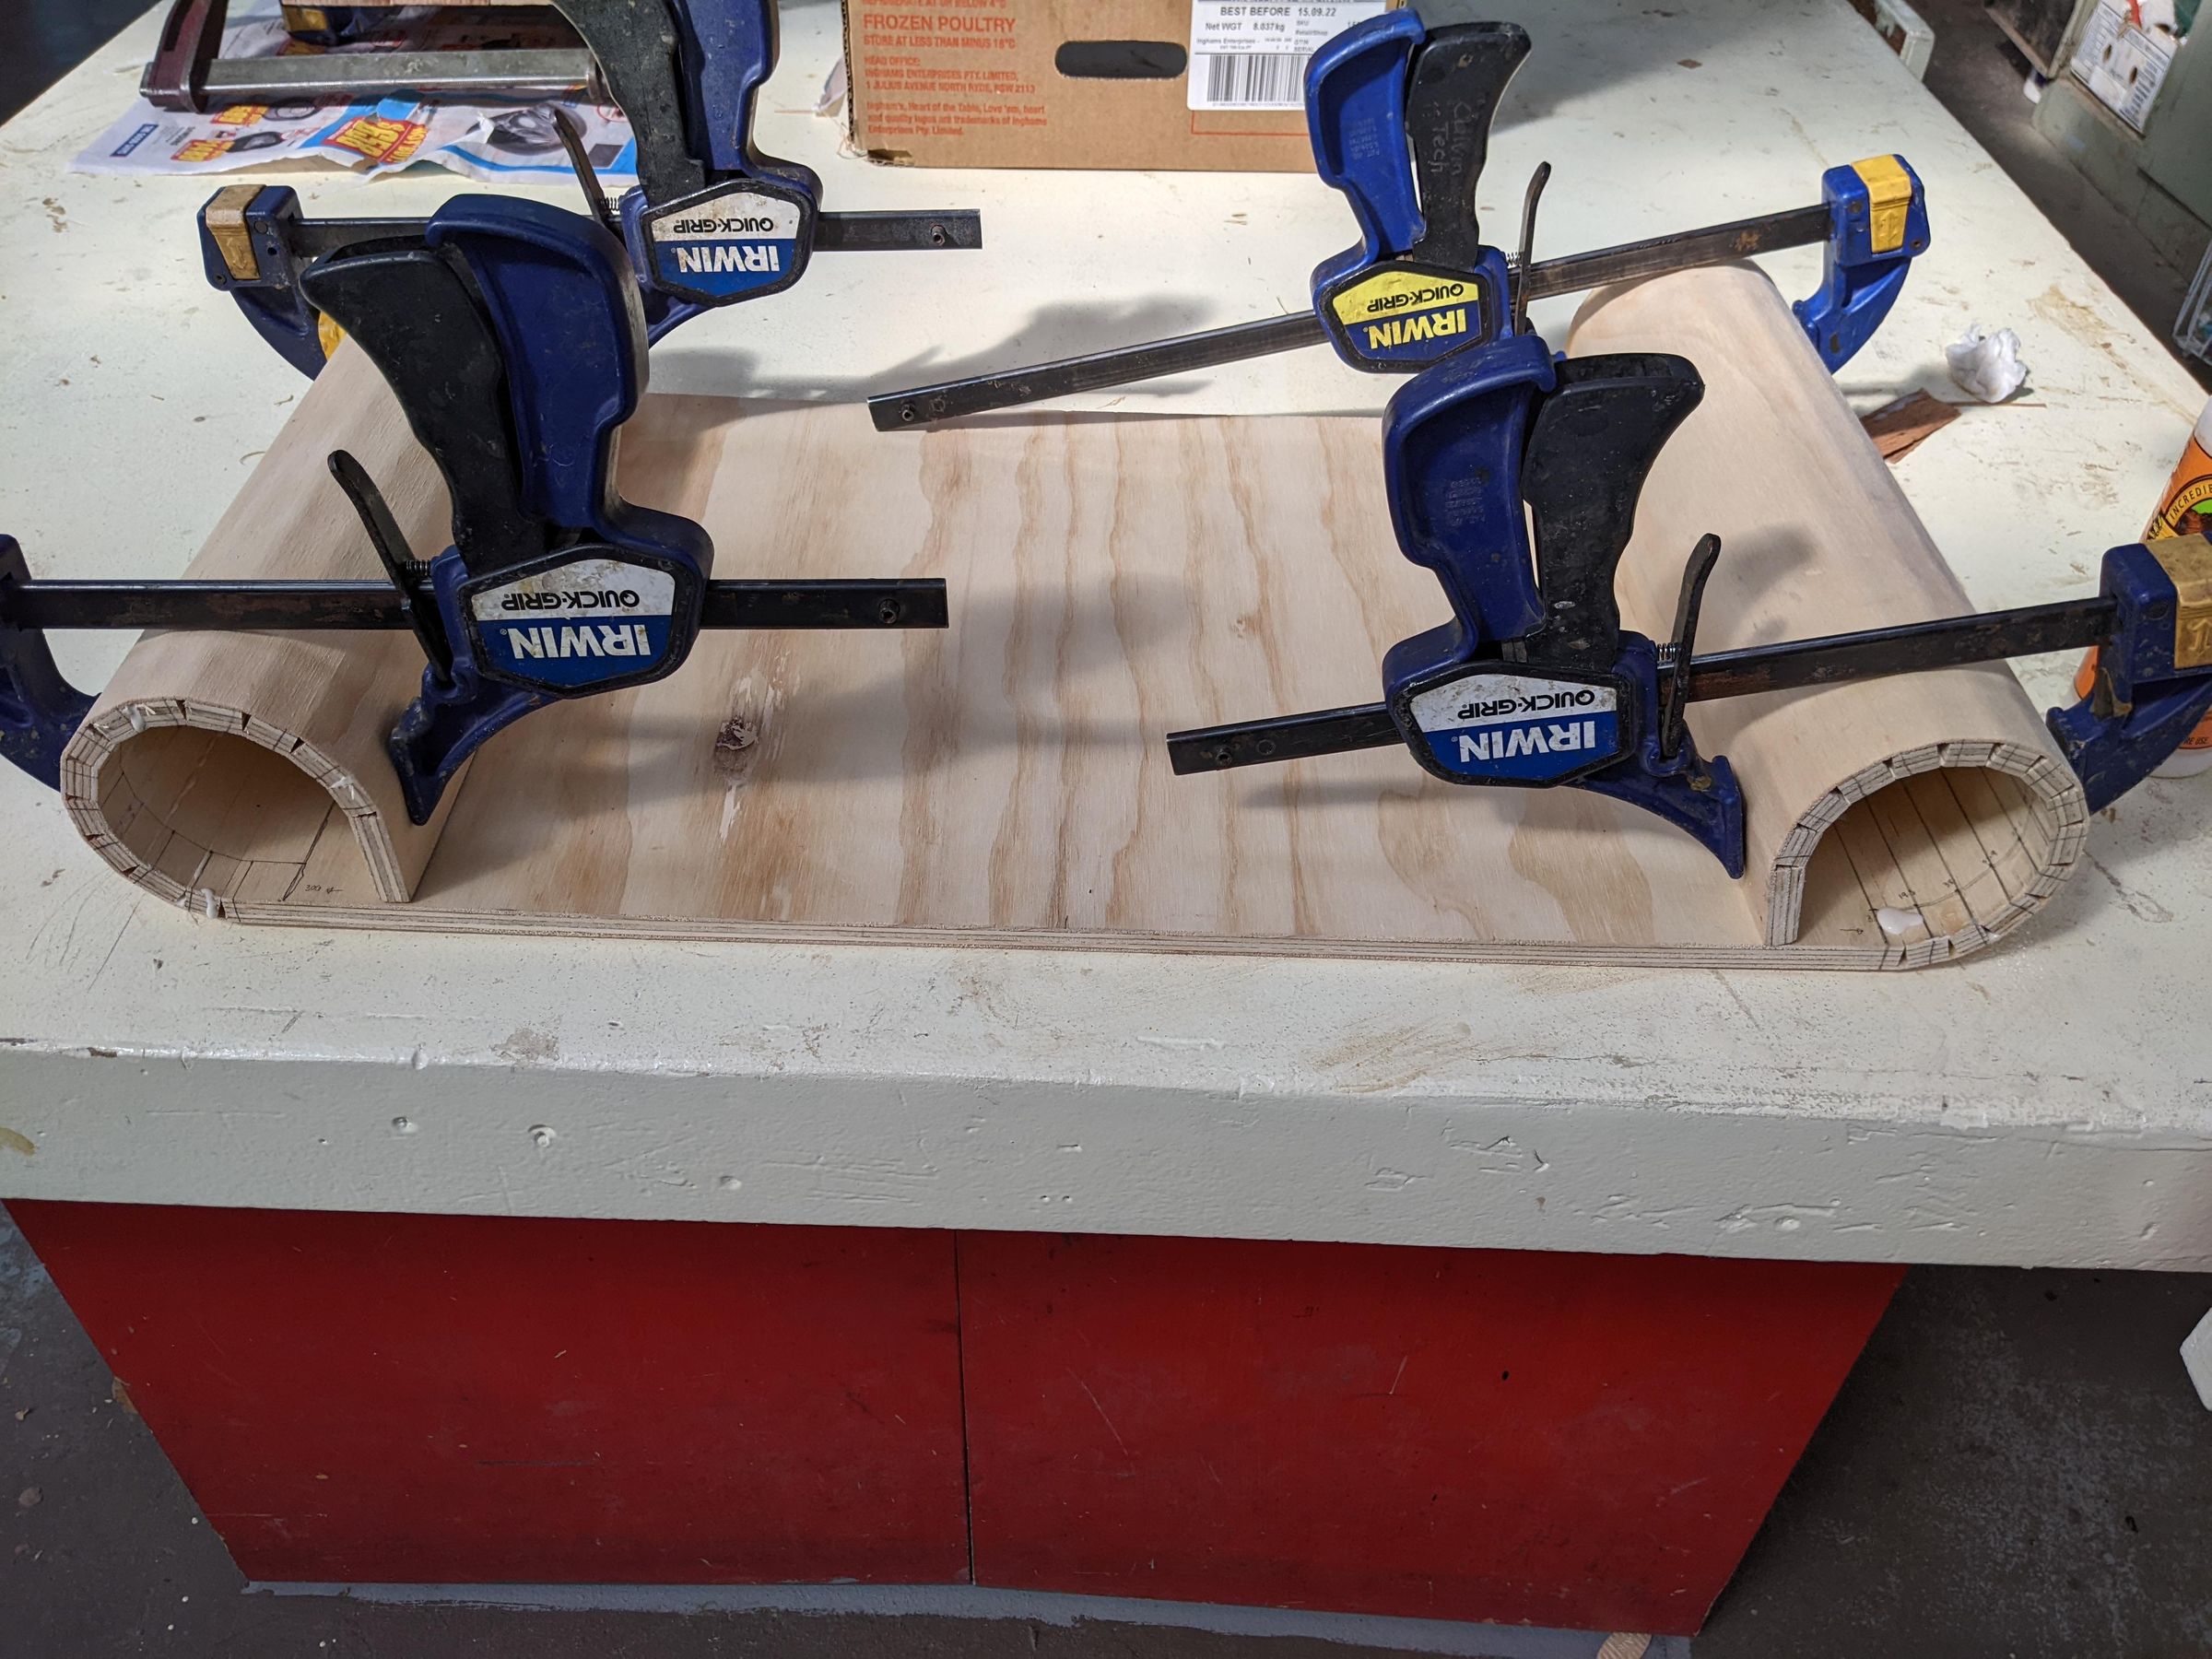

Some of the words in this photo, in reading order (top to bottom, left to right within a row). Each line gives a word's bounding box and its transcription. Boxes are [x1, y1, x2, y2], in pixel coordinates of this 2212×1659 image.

[1219, 6, 1247, 16] BEST
[1250, 7, 1290, 16] BEFORE
[1298, 7, 1336, 17] 15.09.22
[863, 14, 933, 30] FROZEN
[937, 16, 1016, 33] POULTRY
[1205, 22, 1220, 30] Net
[1221, 22, 1242, 30] WGT
[864, 35, 893, 46] STORE
[895, 36, 907, 46] AT
[909, 37, 933, 47] LESS
[935, 37, 959, 48] THAN
[961, 38, 992, 49] MINUS
[865, 57, 888, 65] HEAD
[865, 69, 905, 78] INGHAMS
[907, 70, 961, 79] ENTERPRISES
[904, 81, 936, 90] AVENUE
[938, 82, 967, 91] NORTH
[994, 84, 1014, 94] NSW
[908, 103, 930, 112] Heart
[932, 103, 941, 112] of
[942, 103, 957, 112] the
[983, 103, 1003, 112] Love
[868, 113, 883, 122] and
[885, 115, 912, 124] quality
[954, 116, 1000, 124] trademarks
[1001, 116, 1011, 125] of
[868, 124, 913, 135] Enterprises
[677, 246, 780, 273] IRWIN
[1368, 308, 1467, 349] IRWIN
[508, 625, 652, 659] IRWIN
[1459, 720, 1596, 763] IRWIN
